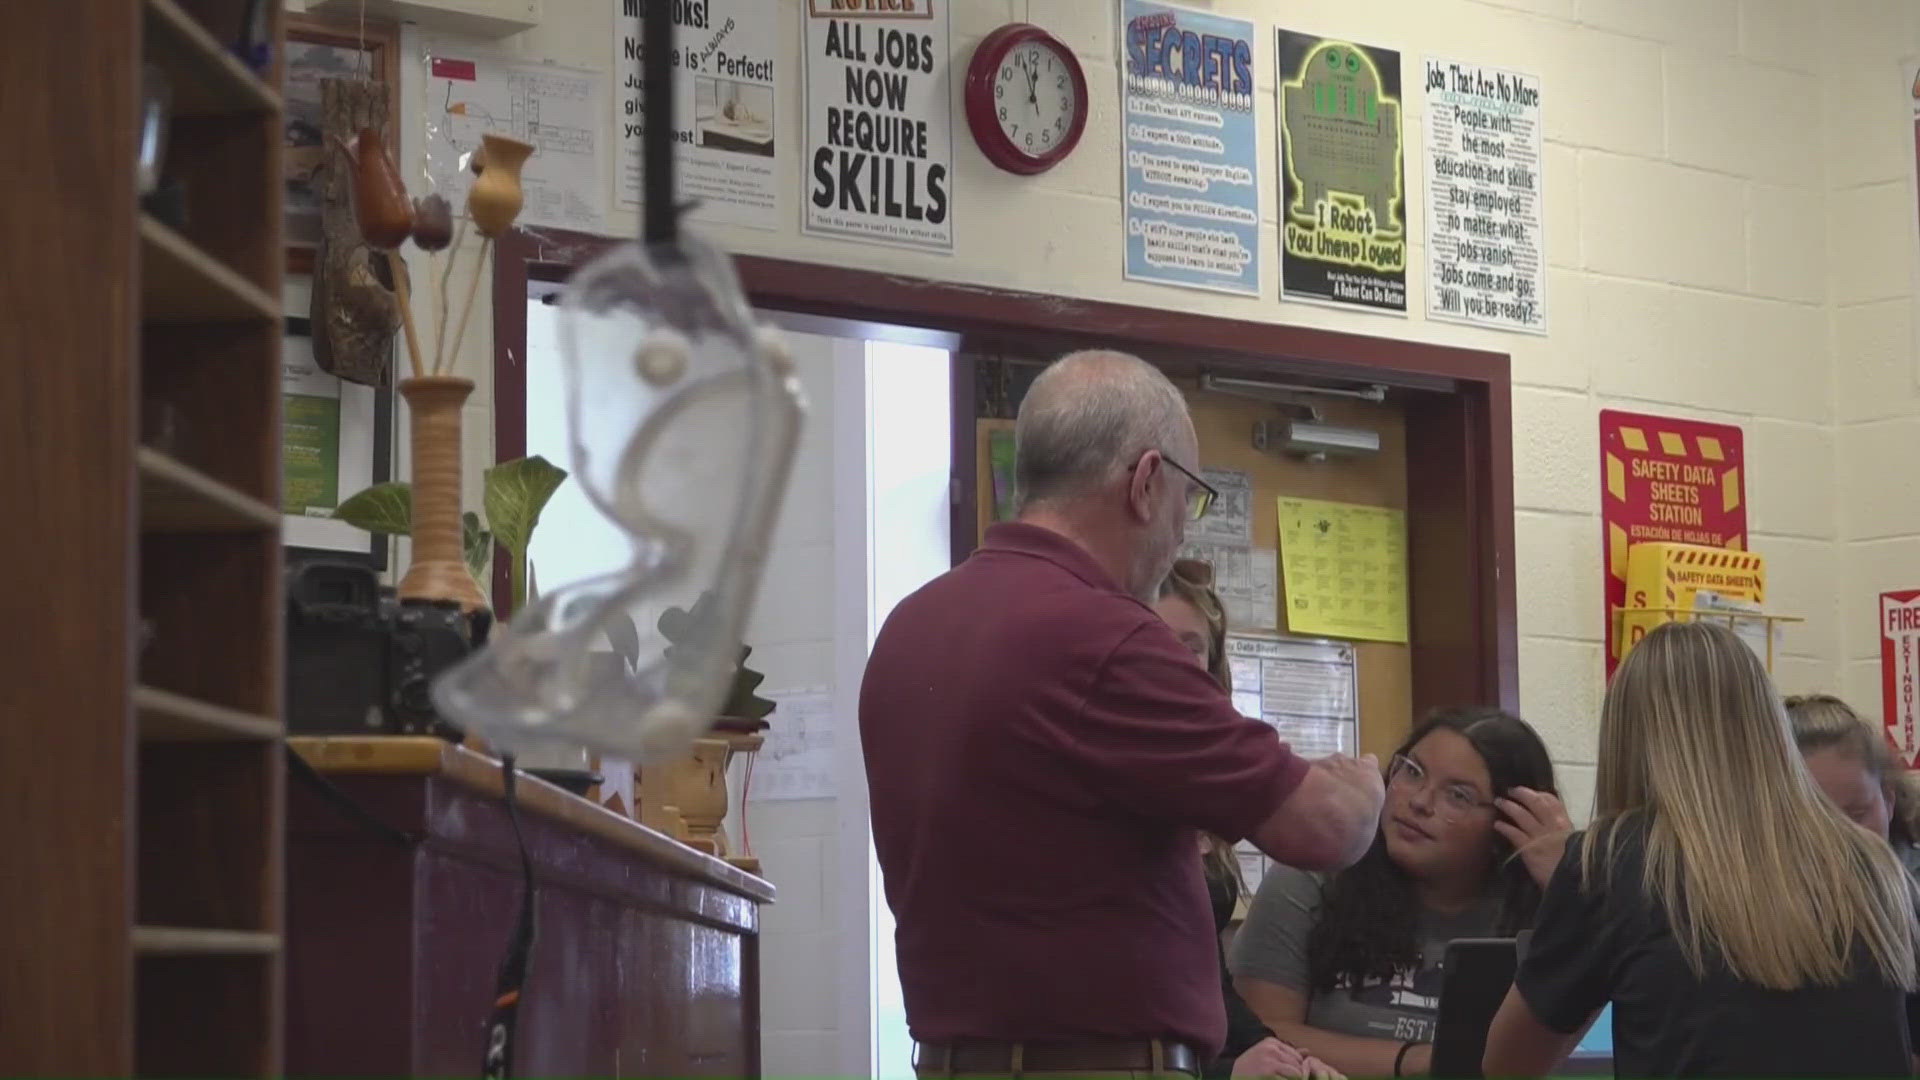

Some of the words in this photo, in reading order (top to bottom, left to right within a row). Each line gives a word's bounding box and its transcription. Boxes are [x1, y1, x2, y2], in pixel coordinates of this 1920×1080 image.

[699, 16, 735, 63] ALWAYS
[825, 19, 867, 62] ALL
[874, 28, 934, 74] JOBS
[685, 47, 698, 70] is
[717, 51, 773, 81] Perfect!
[1015, 52, 1021, 68] 11
[1029, 49, 1040, 66] 12
[1126, 19, 1252, 97] SECRETS
[1001, 66, 1013, 81] 10
[1057, 75, 1065, 89] 2
[1425, 60, 1445, 94] Jobs
[1449, 64, 1473, 95] That
[1476, 68, 1495, 100] Are
[1497, 72, 1511, 103] No
[1513, 75, 1539, 108] More
[845, 66, 908, 112] NOW
[996, 84, 1004, 99] 9
[999, 107, 1007, 121] 8
[1060, 96, 1068, 111] 3
[1011, 123, 1018, 138] 7
[1055, 117, 1061, 131] 4
[1454, 104, 1487, 132] People
[1490, 113, 1511, 134] with
[671, 128, 694, 144] est
[827, 107, 928, 159] REQUIRE
[1025, 132, 1033, 146] 6
[1042, 129, 1050, 143] 5
[1462, 132, 1478, 154] the
[1481, 139, 1505, 159] most
[1435, 156, 1484, 181] education
[1487, 166, 1505, 185] and
[1508, 167, 1534, 190] skills
[812, 147, 947, 224] SKILLS
[1449, 187, 1470, 210] stay
[1473, 191, 1521, 217] employed
[1318, 203, 1325, 228] I
[1331, 205, 1373, 234] Robot
[1448, 214, 1460, 231] no
[1463, 215, 1497, 237] matter
[1500, 220, 1524, 241] what
[1288, 226, 1313, 253] You
[1317, 231, 1402, 266] Unemployed
[1457, 240, 1478, 262] jobs
[1440, 263, 1464, 285] Jobs
[1466, 270, 1493, 289] come
[1496, 273, 1514, 292] and
[1334, 281, 1339, 296] A
[1361, 284, 1373, 301] Can
[1440, 288, 1460, 313] Will
[1464, 297, 1481, 316] you
[1485, 296, 1497, 317] be
[1500, 301, 1534, 324] ready?
[1632, 458, 1680, 481] SAFETY
[1684, 465, 1716, 486] DATA
[1650, 481, 1699, 505] SHEETS
[1649, 504, 1702, 526] STATION
[1631, 524, 1670, 540] ESTACIÓN
[1672, 529, 1682, 541] DE
[1684, 530, 1710, 544] HOJAS
[1712, 534, 1723, 545] DE
[1677, 571, 1705, 583] SAFETY
[1707, 573, 1724, 585] DATA
[1726, 576, 1754, 588] SHEETS
[1634, 590, 1647, 608] S
[1902, 635, 1915, 752] EXTINGUISHER
[1394, 1017, 1428, 1041] EST
